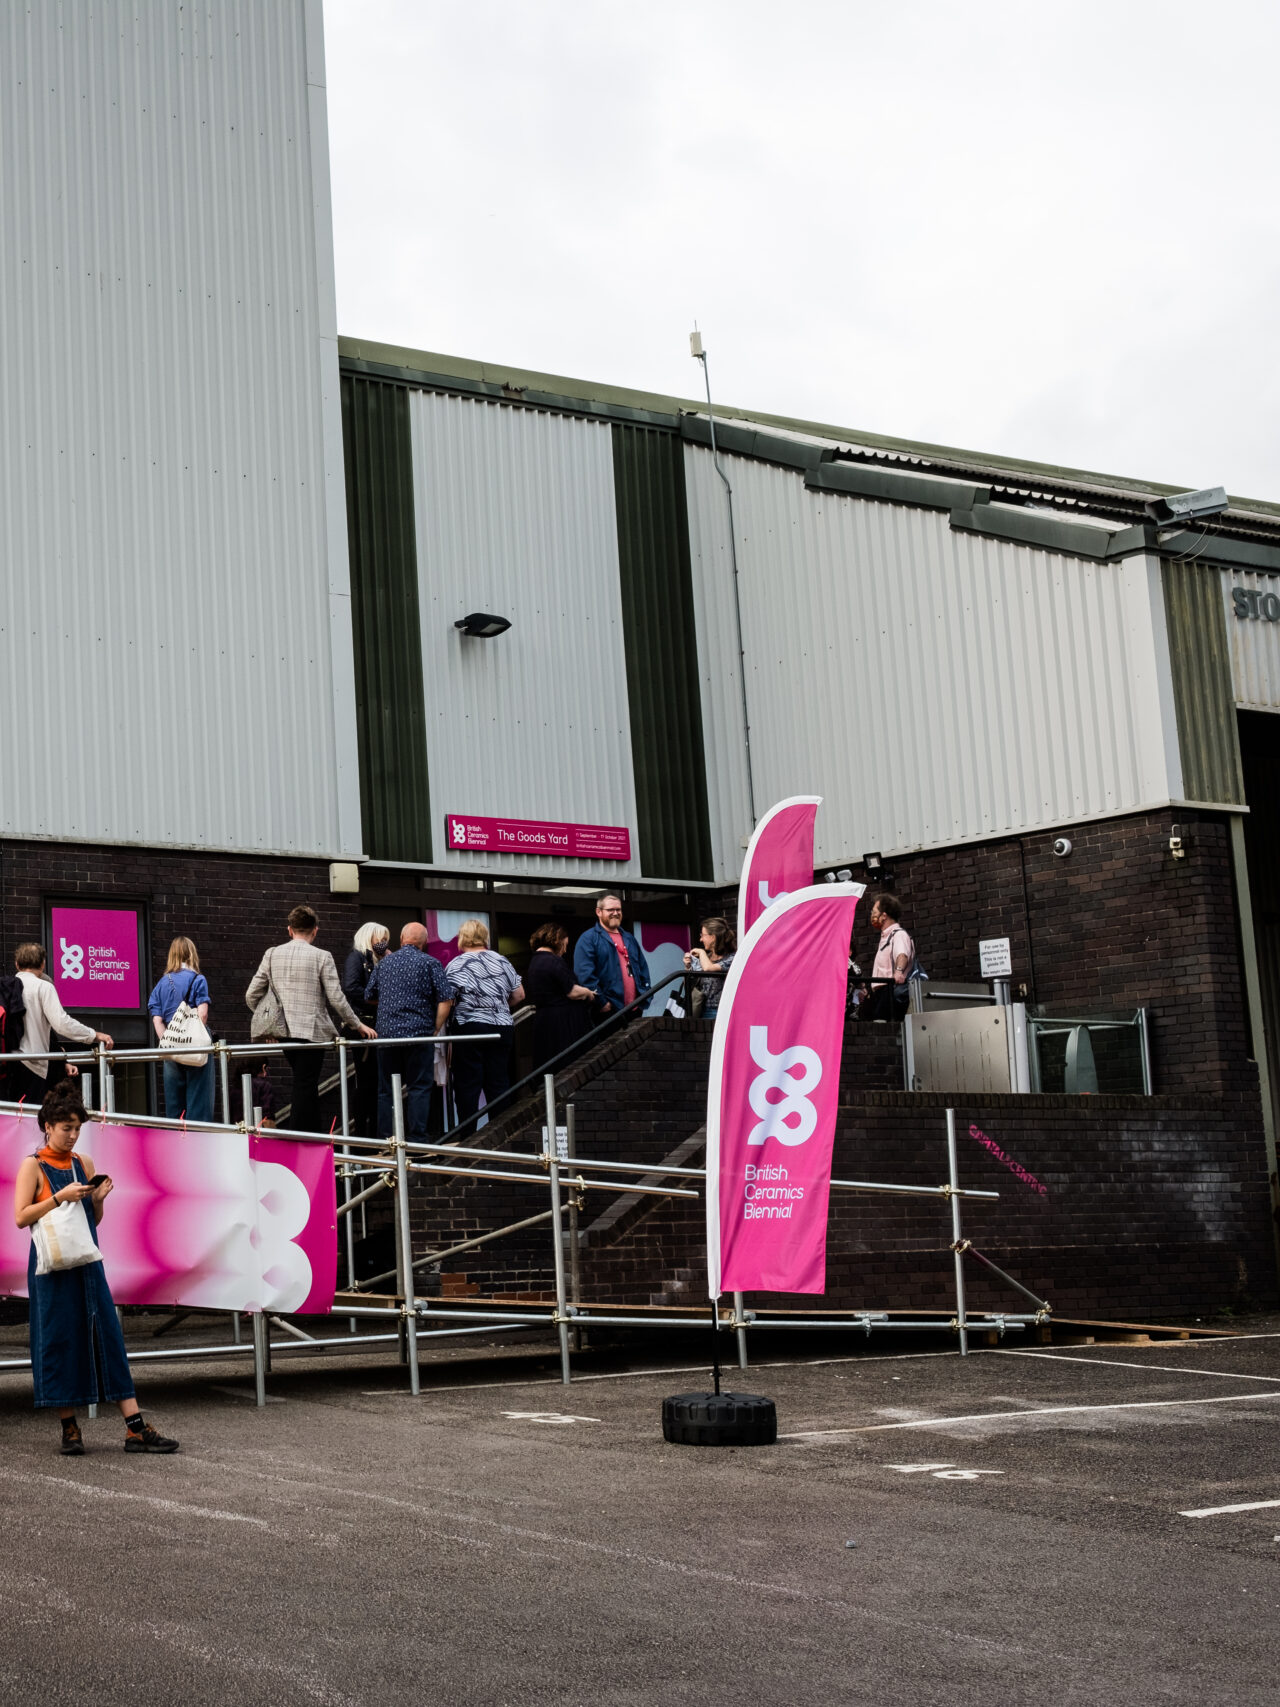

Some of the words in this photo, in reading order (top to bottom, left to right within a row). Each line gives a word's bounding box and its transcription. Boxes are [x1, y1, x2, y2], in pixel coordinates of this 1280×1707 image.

[497, 829, 515, 841] The
[517, 831, 546, 844] Goods
[547, 833, 569, 846] Yard
[88, 946, 117, 957] British
[88, 958, 130, 970] Ceramics
[89, 969, 124, 981] Biennial
[744, 1163, 788, 1182] British
[744, 1183, 805, 1200] Ceramics
[743, 1202, 793, 1220] Biennial
